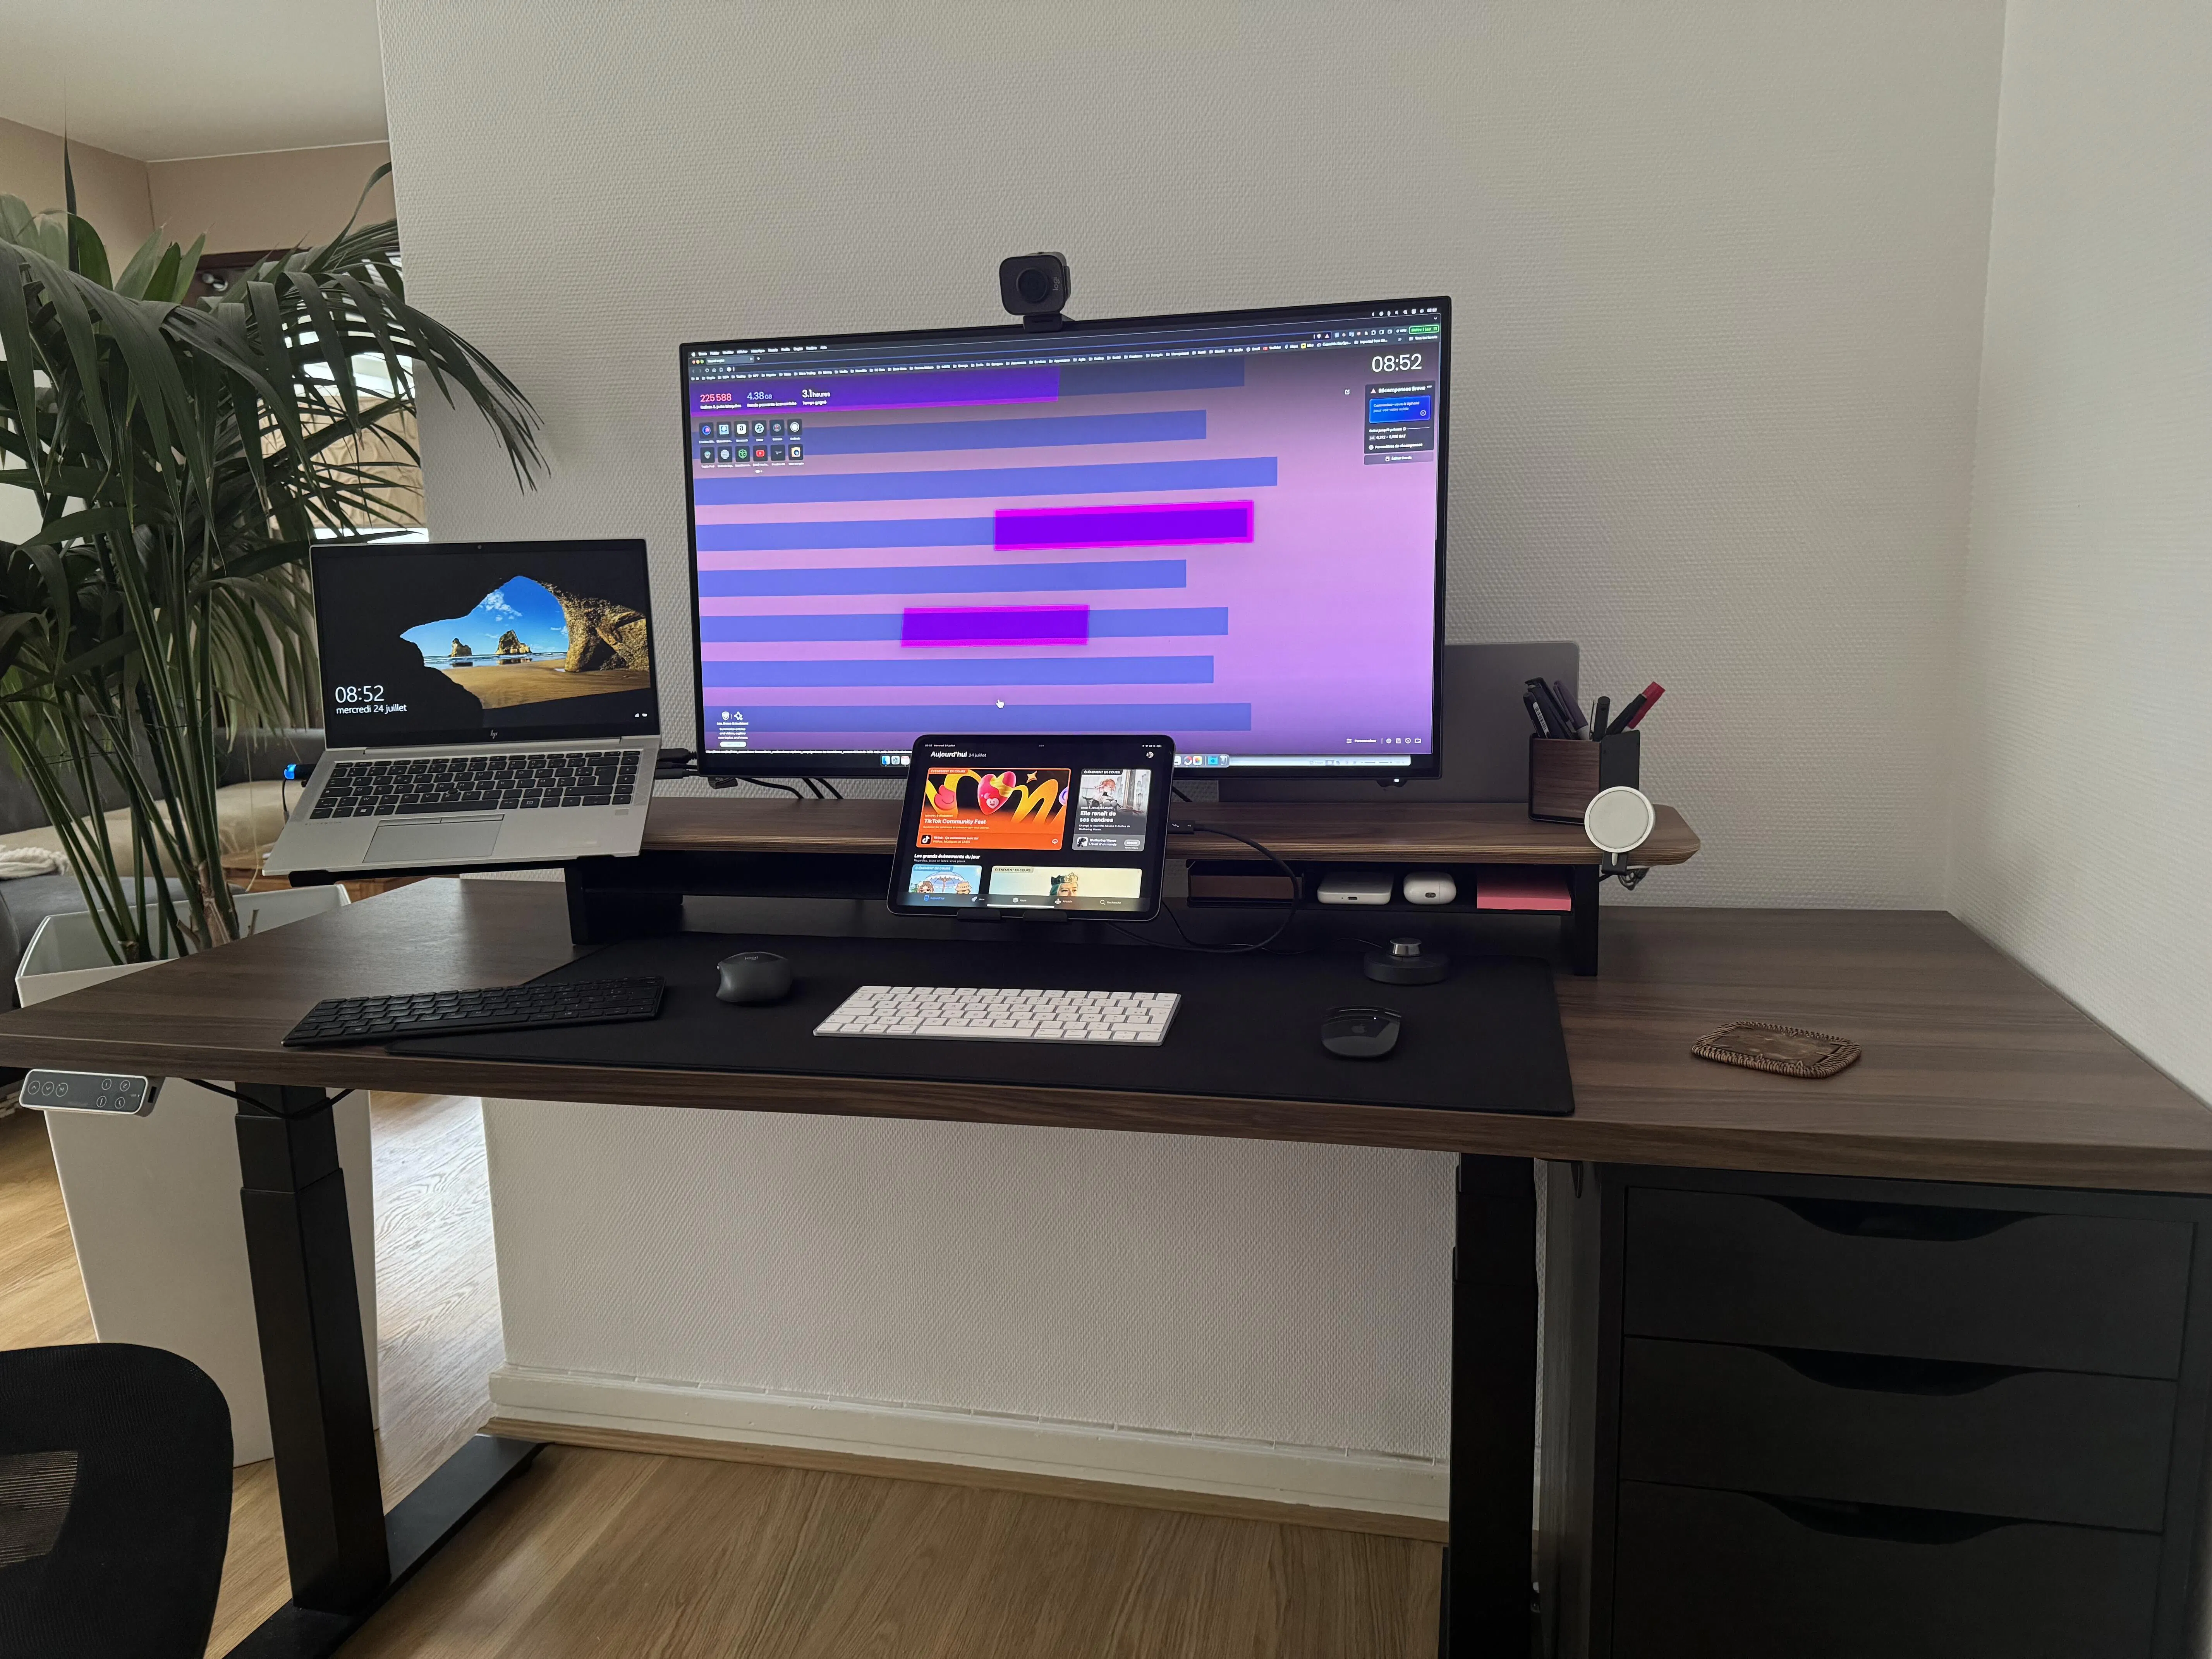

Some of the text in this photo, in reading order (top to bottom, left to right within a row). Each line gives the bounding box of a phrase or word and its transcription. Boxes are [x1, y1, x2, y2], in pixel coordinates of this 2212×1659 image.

[1372, 353, 1422, 373] 08:52
[700, 394, 715, 402] 225
[747, 392, 764, 400] 4.38
[802, 390, 812, 398] 3.1
[335, 685, 385, 703] 08:52
[336, 705, 371, 714] mercredi
[385, 704, 407, 714] juillet
